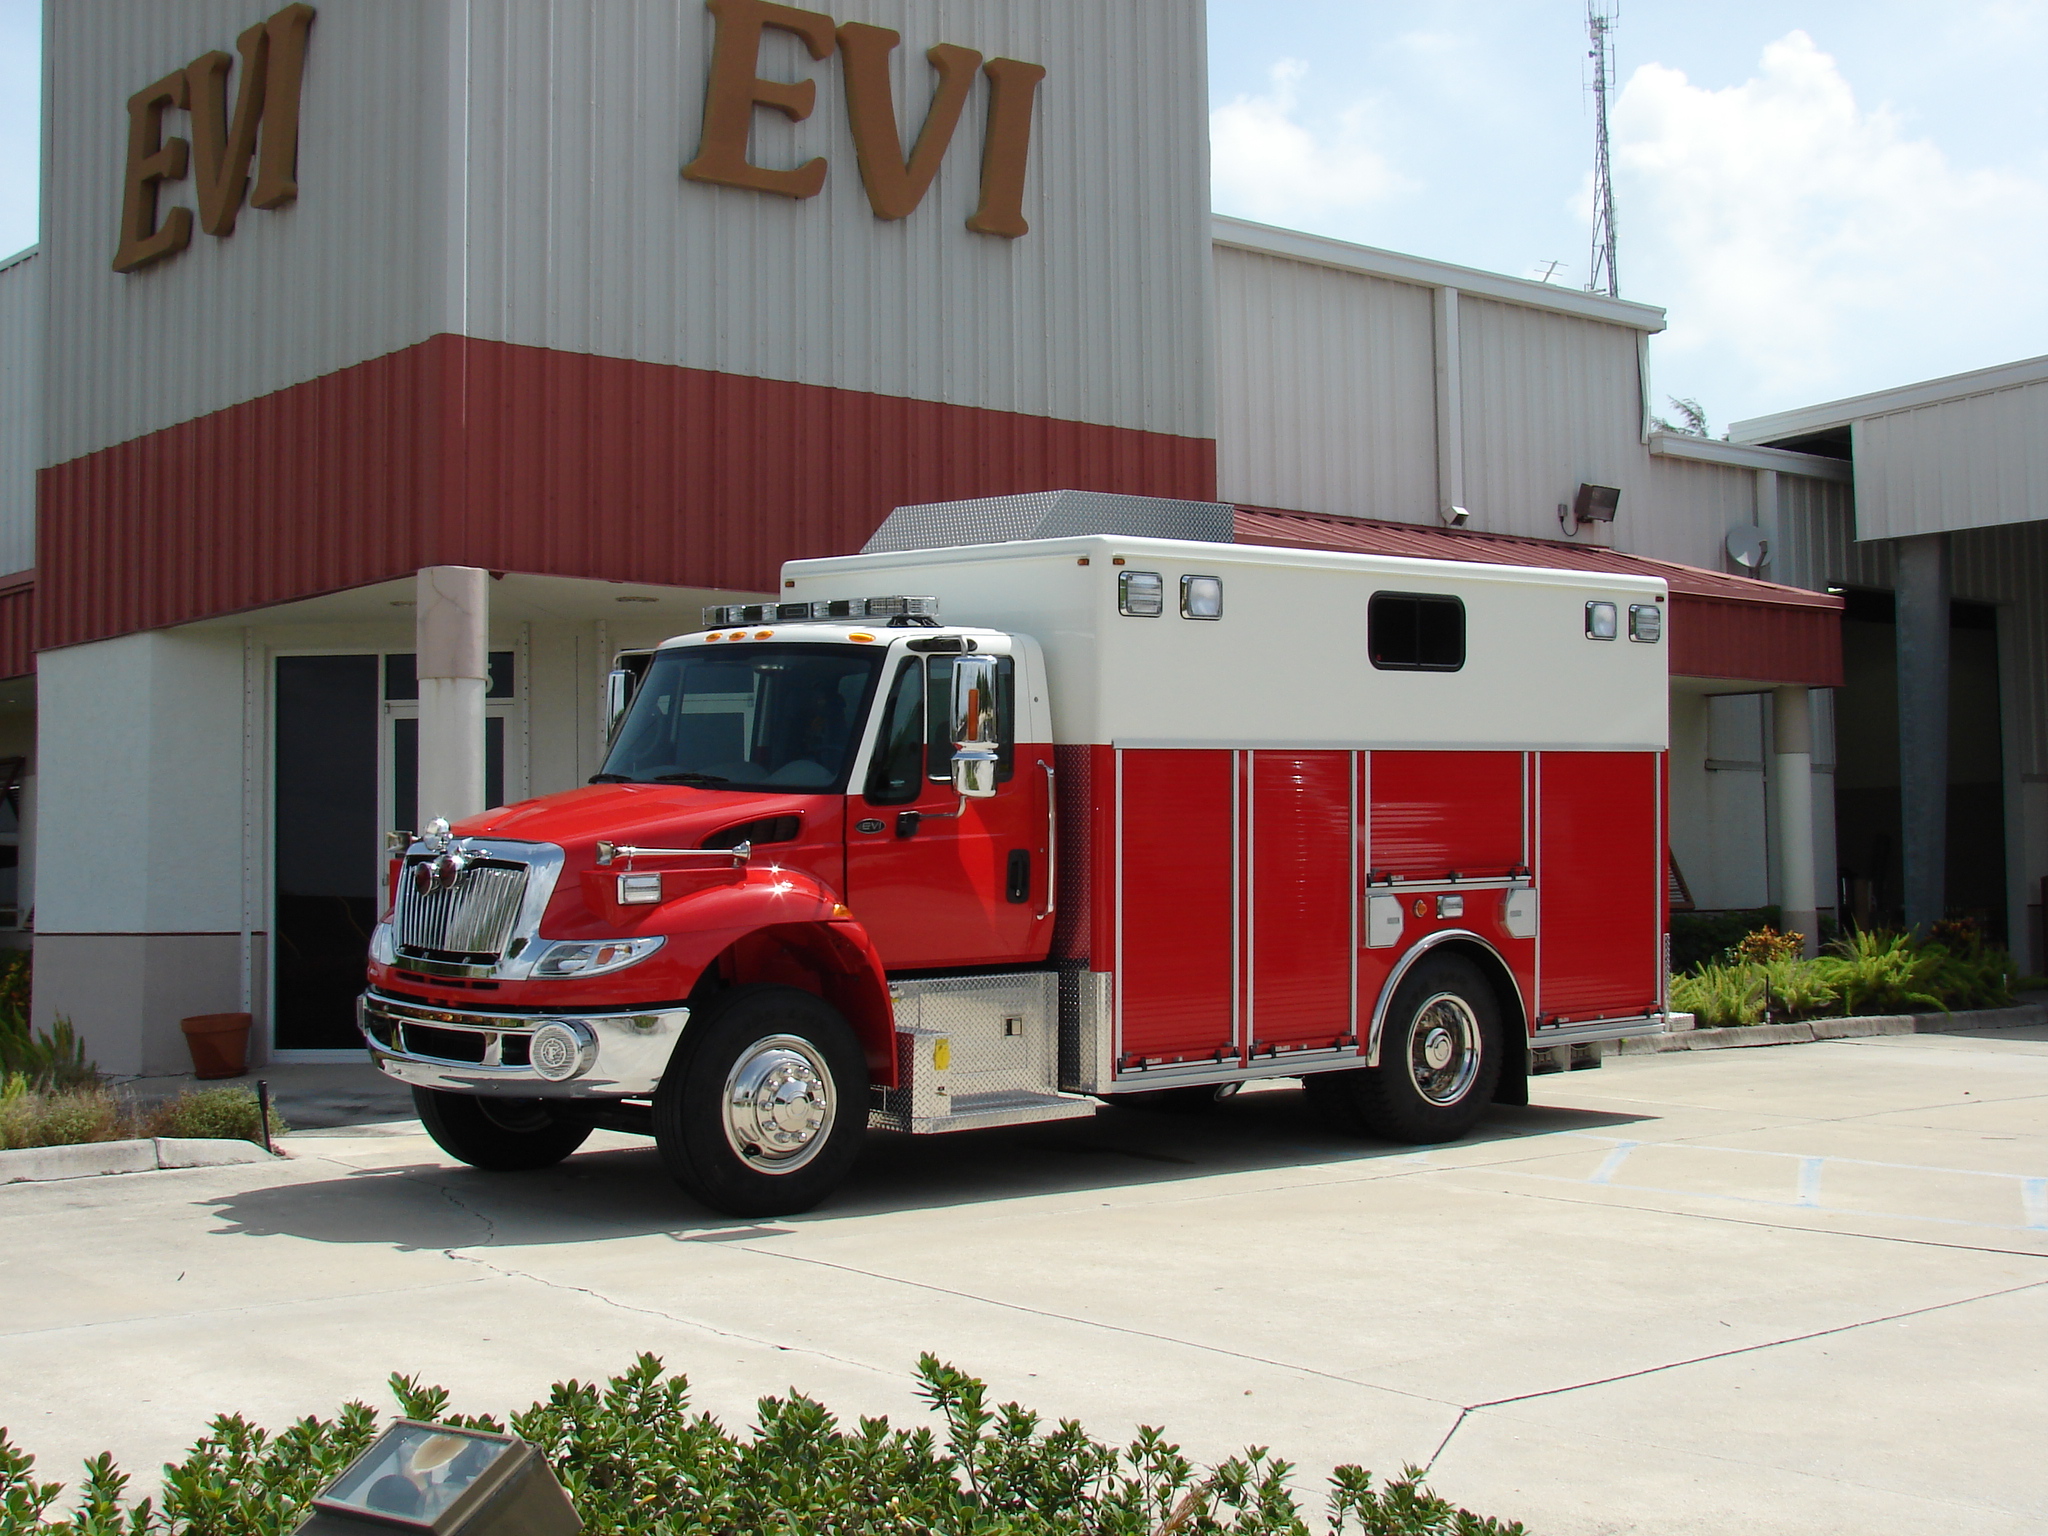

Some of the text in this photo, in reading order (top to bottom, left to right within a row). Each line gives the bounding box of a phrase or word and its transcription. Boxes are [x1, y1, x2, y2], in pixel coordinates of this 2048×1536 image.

[112, 2, 316, 273] EVI
[681, 0, 1046, 239] EVI
[862, 821, 882, 831] EVI
